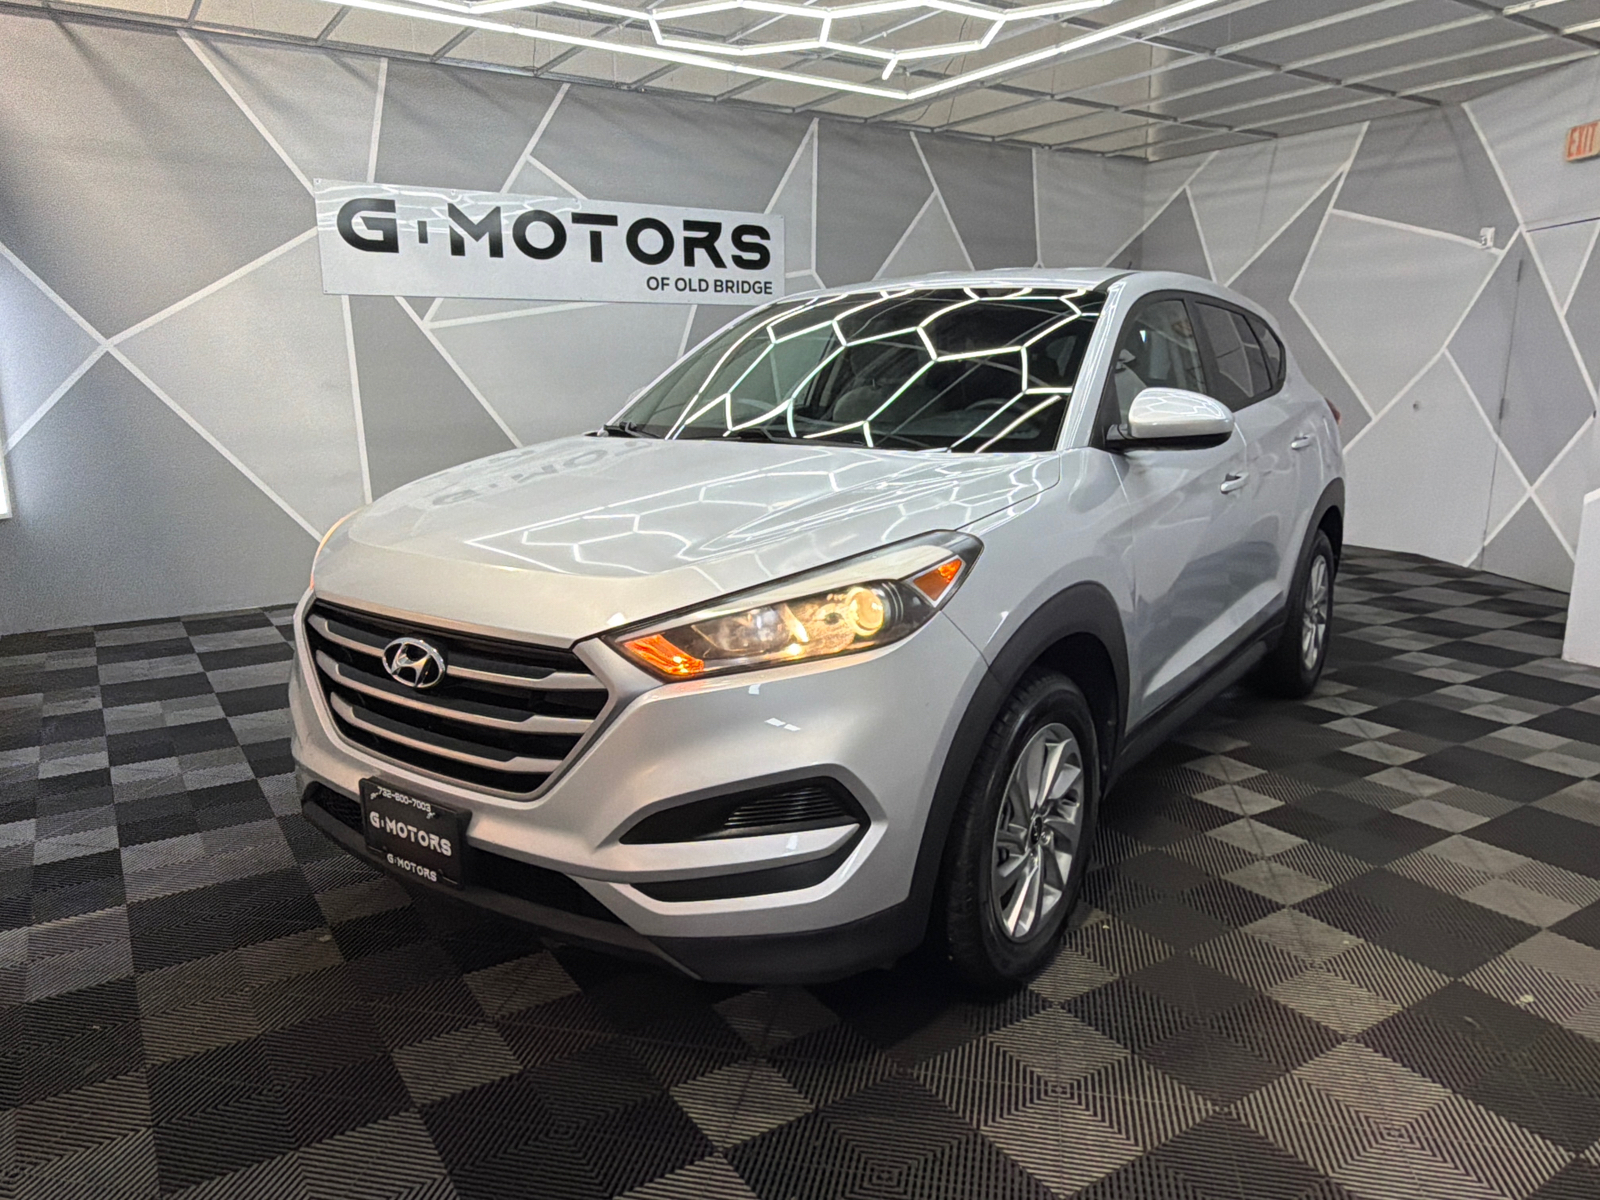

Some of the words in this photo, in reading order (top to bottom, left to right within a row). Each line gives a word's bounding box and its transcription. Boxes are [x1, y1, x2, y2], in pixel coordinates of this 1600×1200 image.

[1567, 122, 1597, 158] EXIT
[646, 276, 671, 292] OF
[675, 277, 709, 294] OLD
[713, 279, 773, 296] BRIDGE
